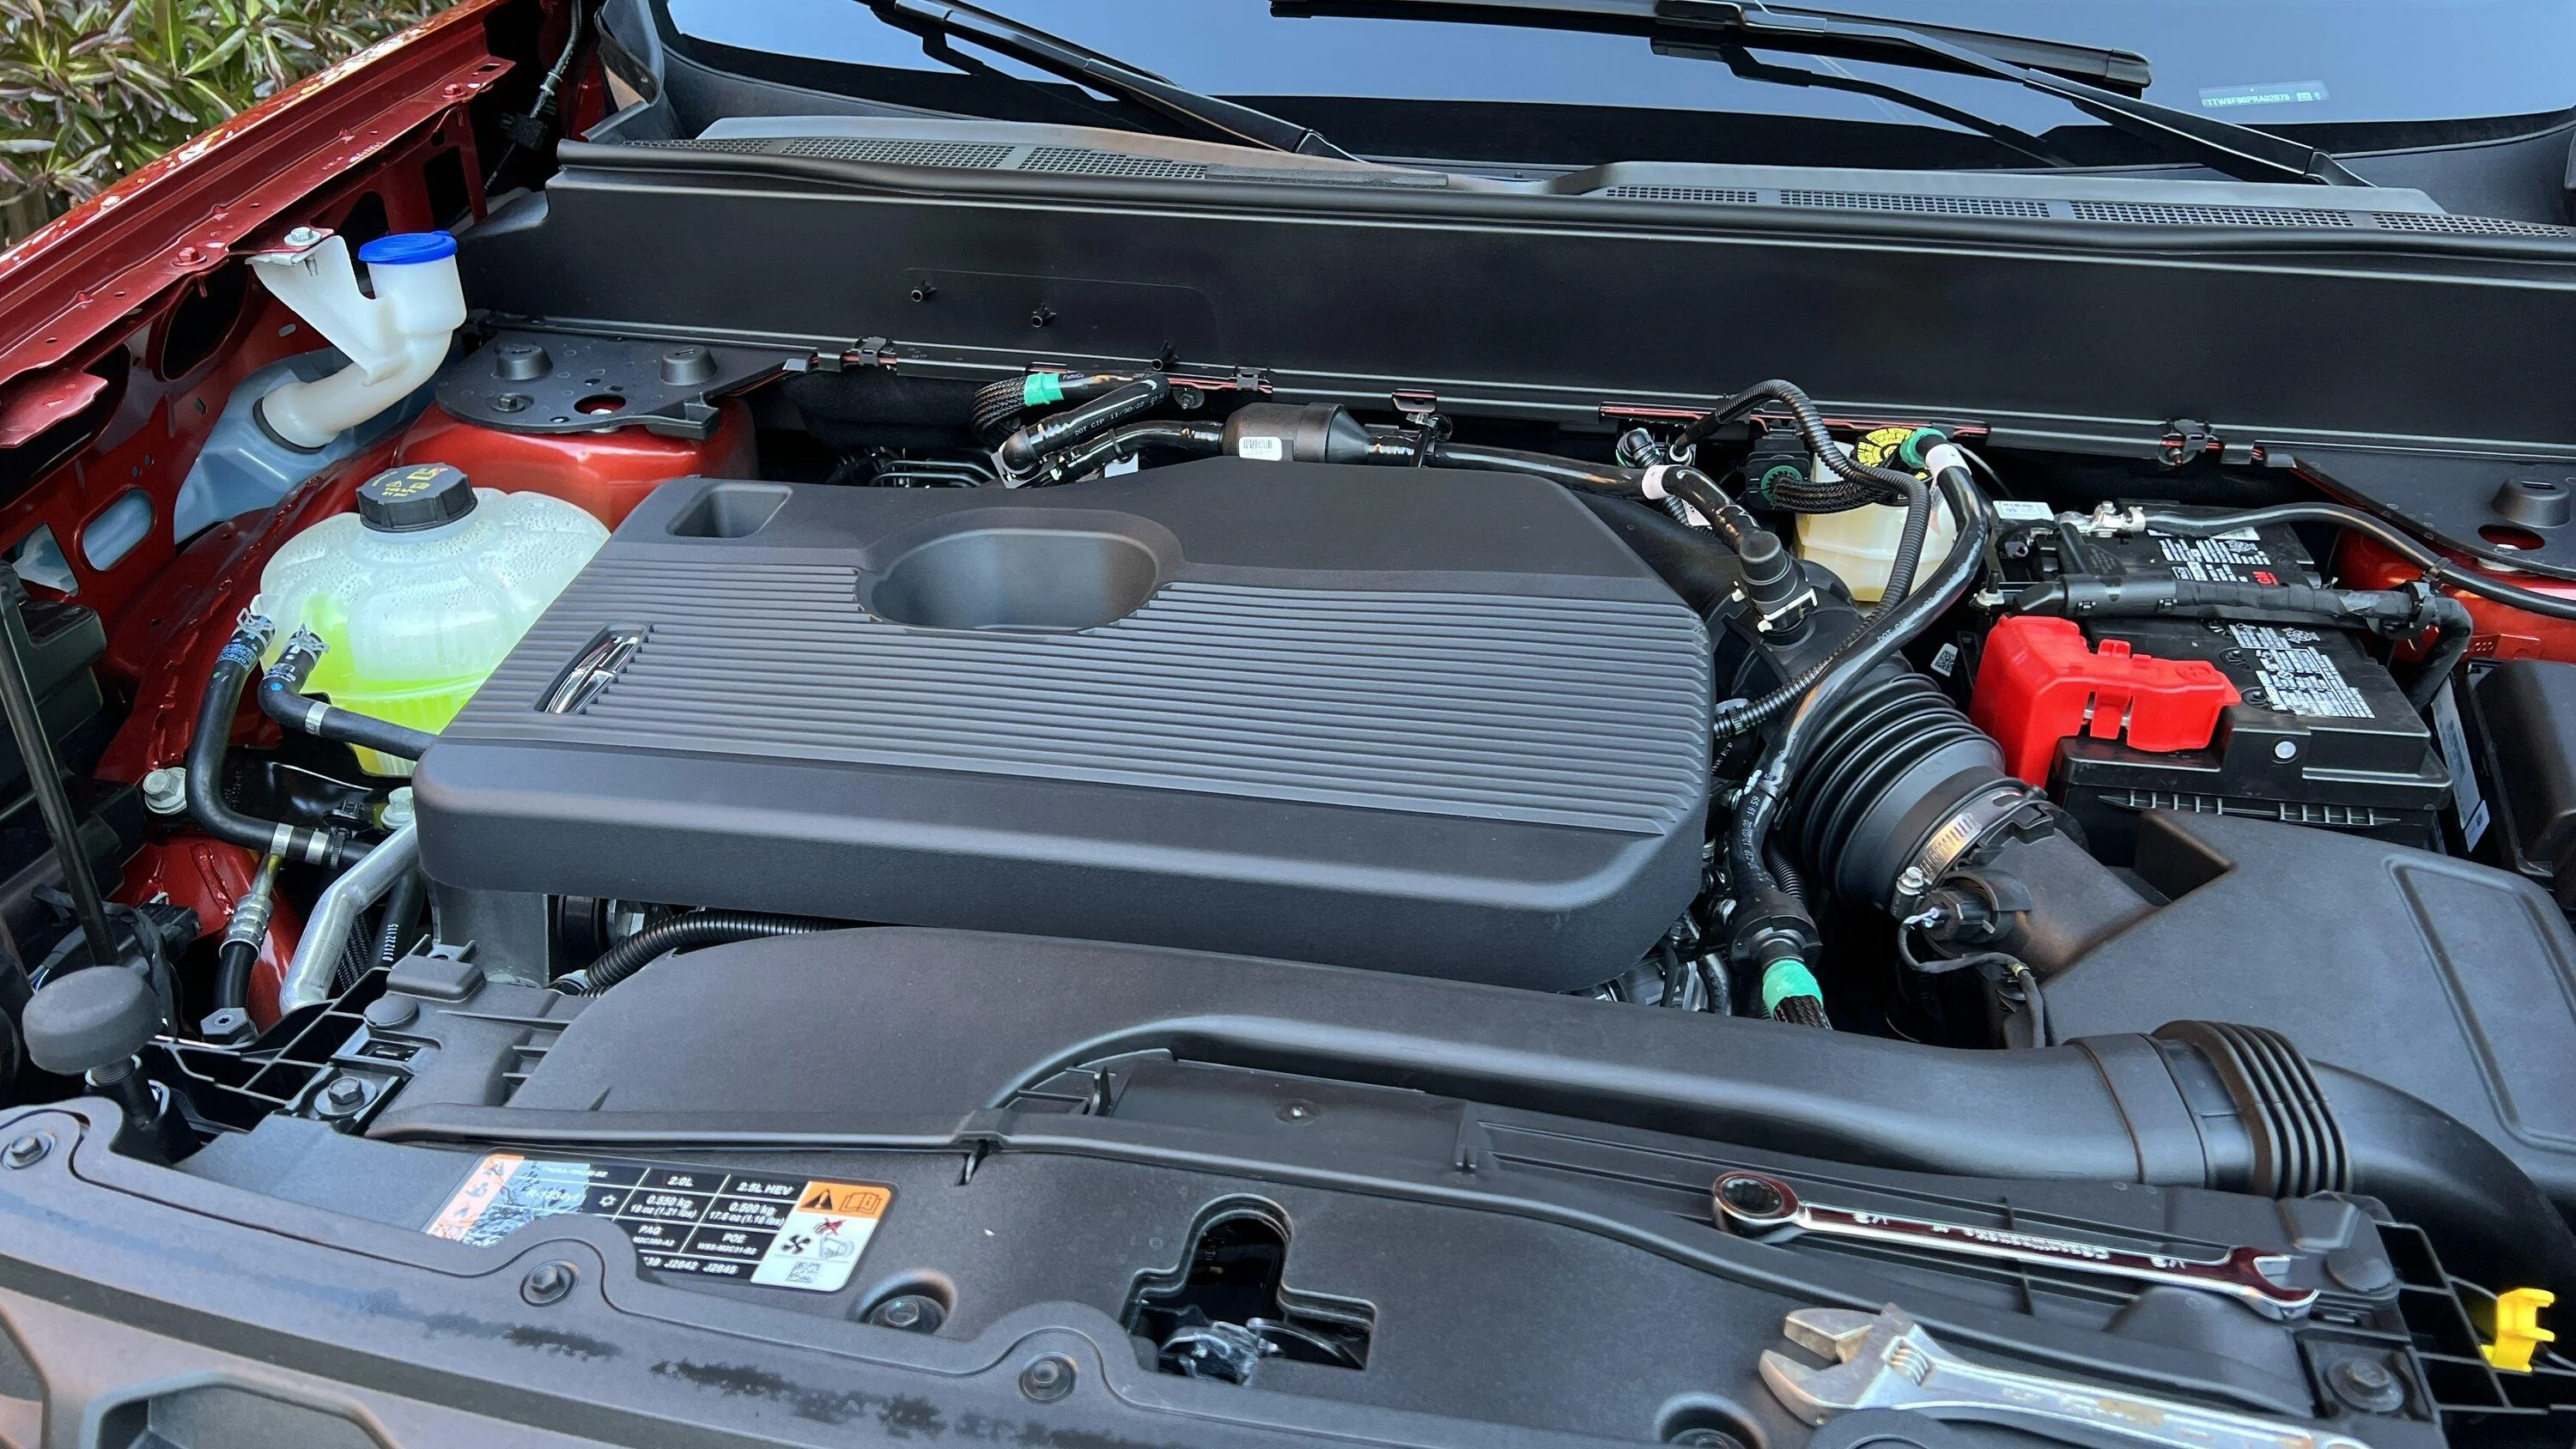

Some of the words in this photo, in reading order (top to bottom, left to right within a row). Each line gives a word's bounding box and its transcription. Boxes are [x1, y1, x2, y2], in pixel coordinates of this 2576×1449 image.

[666, 1175, 694, 1188] 2.0L
[736, 1181, 762, 1194] 2.5L
[763, 1183, 794, 1197] HEV
[646, 1194, 677, 1207] 0.550
[677, 1197, 694, 1210] kg
[728, 1201, 761, 1214] 0.500
[761, 1204, 779, 1217] kg
